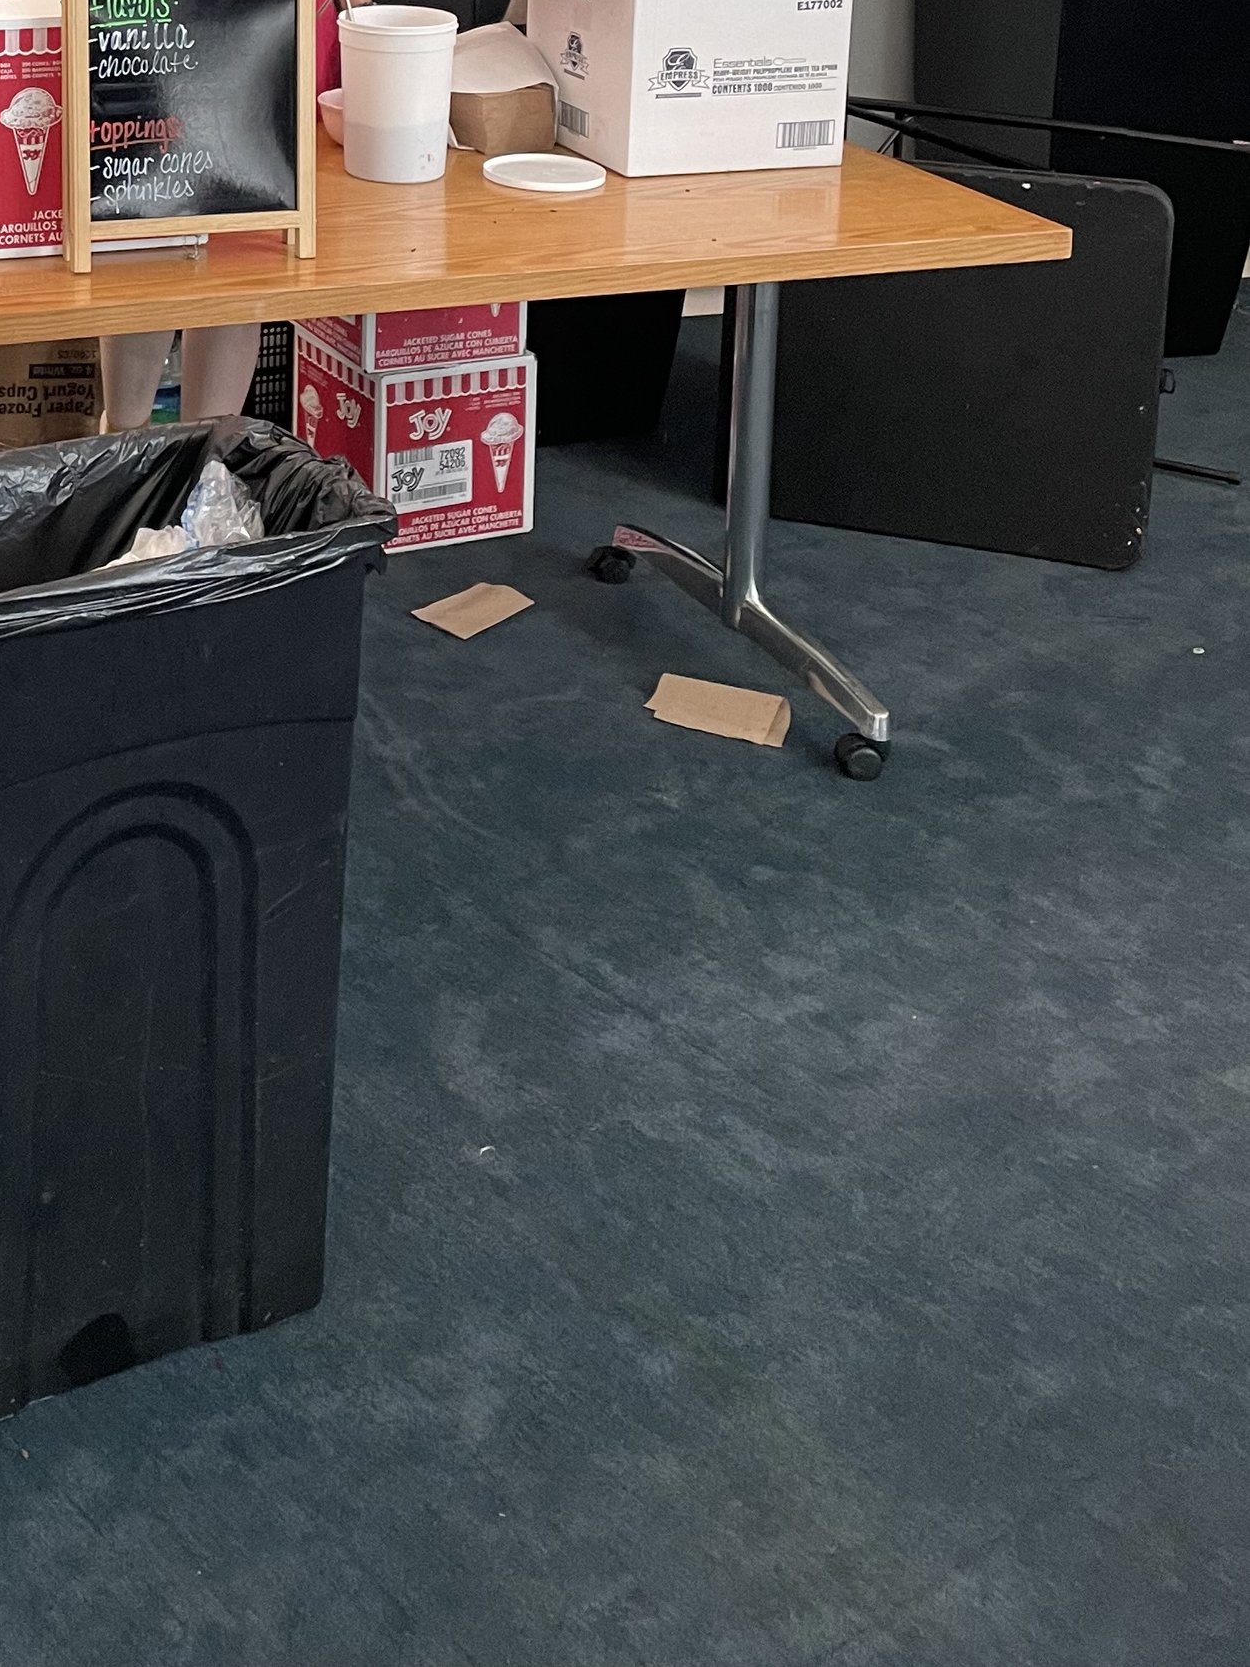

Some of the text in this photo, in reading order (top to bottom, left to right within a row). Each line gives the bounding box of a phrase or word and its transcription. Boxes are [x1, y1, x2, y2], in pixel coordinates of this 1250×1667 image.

[797, 0, 843, 11] E177002
[713, 56, 772, 69] Essentials
[660, 70, 699, 81] EMPRESS
[712, 84, 751, 94] CONTENTS
[754, 82, 772, 92] 1000
[160, 150, 213, 174] cones
[32, 210, 62, 220] JACKE
[376, 346, 421, 358] BARQUILLOS
[423, 344, 433, 353] DE
[465, 339, 483, 348] CON
[485, 335, 518, 345] CUBIERTA
[403, 329, 492, 347] JACKETED SUGAR CONES
[378, 344, 516, 367] CORNETS AU SUCRE AVEC MANCHETTE
[43, 383, 95, 400] Yogurt
[46, 400, 95, 416] Paper
[398, 524, 429, 536] QUILLOS
[430, 521, 439, 531] DE
[472, 514, 489, 524] CON
[490, 510, 522, 521] CUBIERTA
[411, 505, 497, 526] JACKETED SUGAR CONES
[421, 532, 433, 541] AU
[434, 528, 456, 540] SUCRE
[457, 524, 477, 535] AVEC
